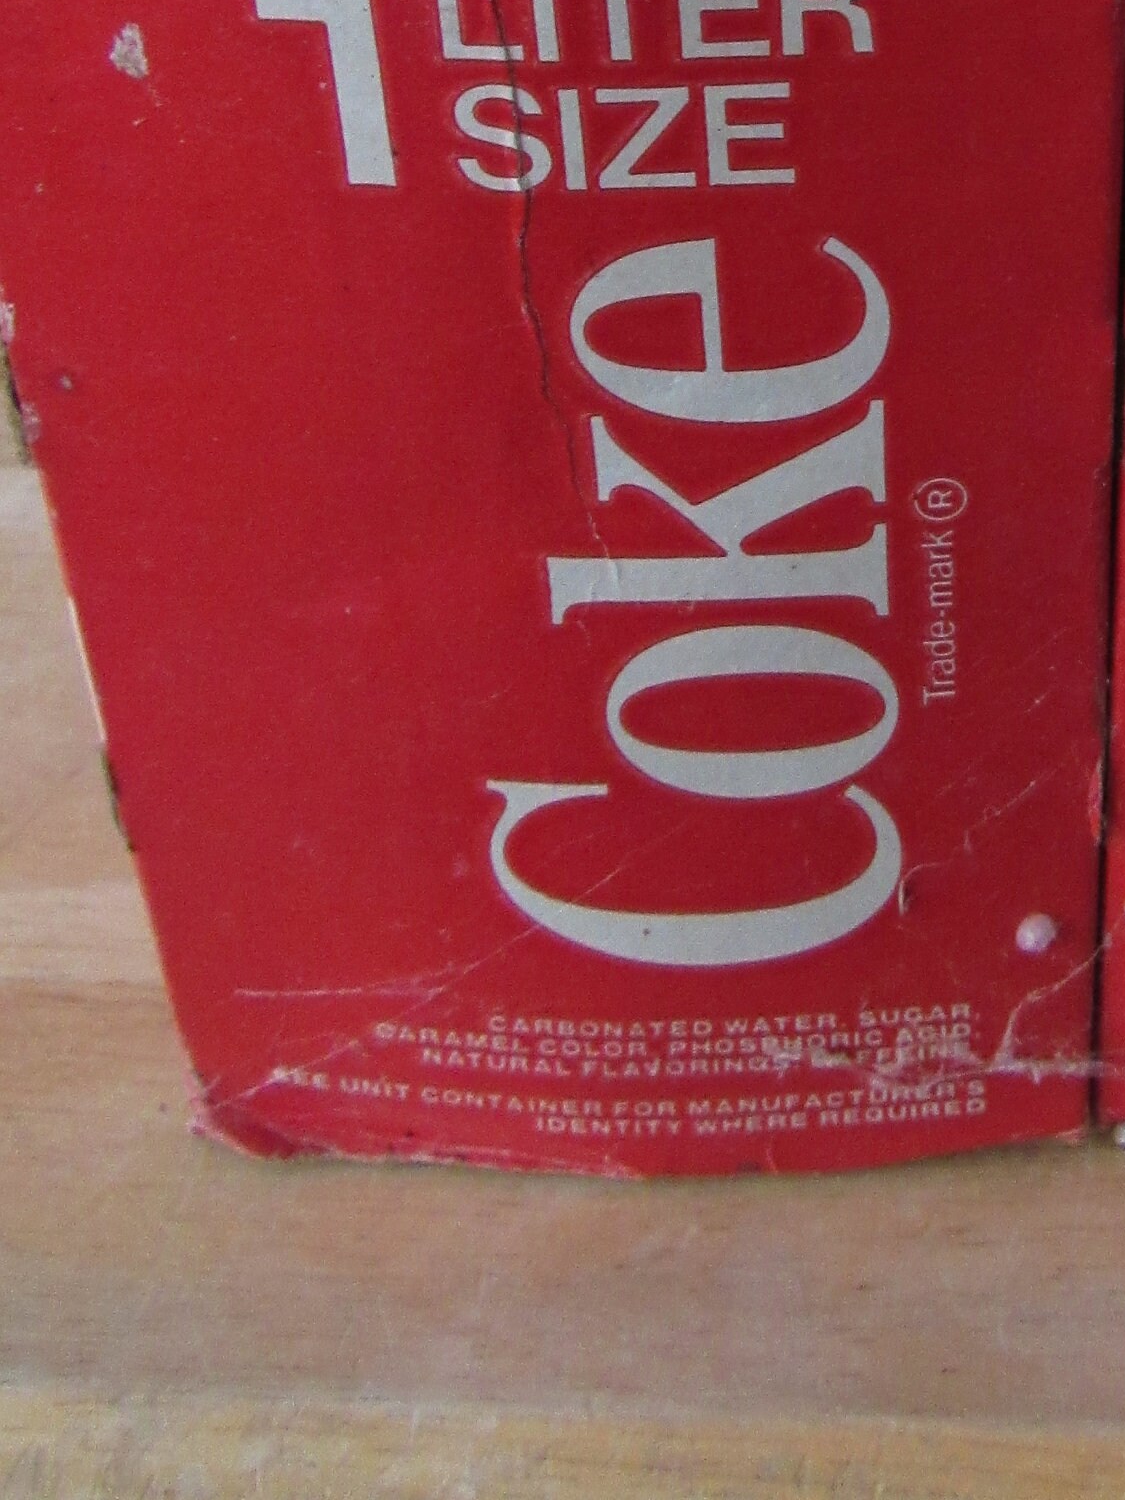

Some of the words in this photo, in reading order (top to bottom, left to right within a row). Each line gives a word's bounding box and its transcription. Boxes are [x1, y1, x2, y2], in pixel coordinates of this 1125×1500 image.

[452, 81, 797, 192] SIZE
[486, 236, 902, 966] Coke
[922, 530, 956, 706] Trade-mark
[373, 1021, 527, 1053] CARAMEL
[488, 1014, 714, 1040] CARBONATED
[421, 1046, 571, 1078] NATURAL
[338, 1075, 412, 1100] UNIT
[419, 1084, 603, 1116] CONTAINER
[612, 1097, 677, 1117] FOR
[534, 1116, 682, 1137] IDENTITY
[694, 1107, 808, 1136] WHERE
[818, 1097, 987, 1127] REQUIRED
